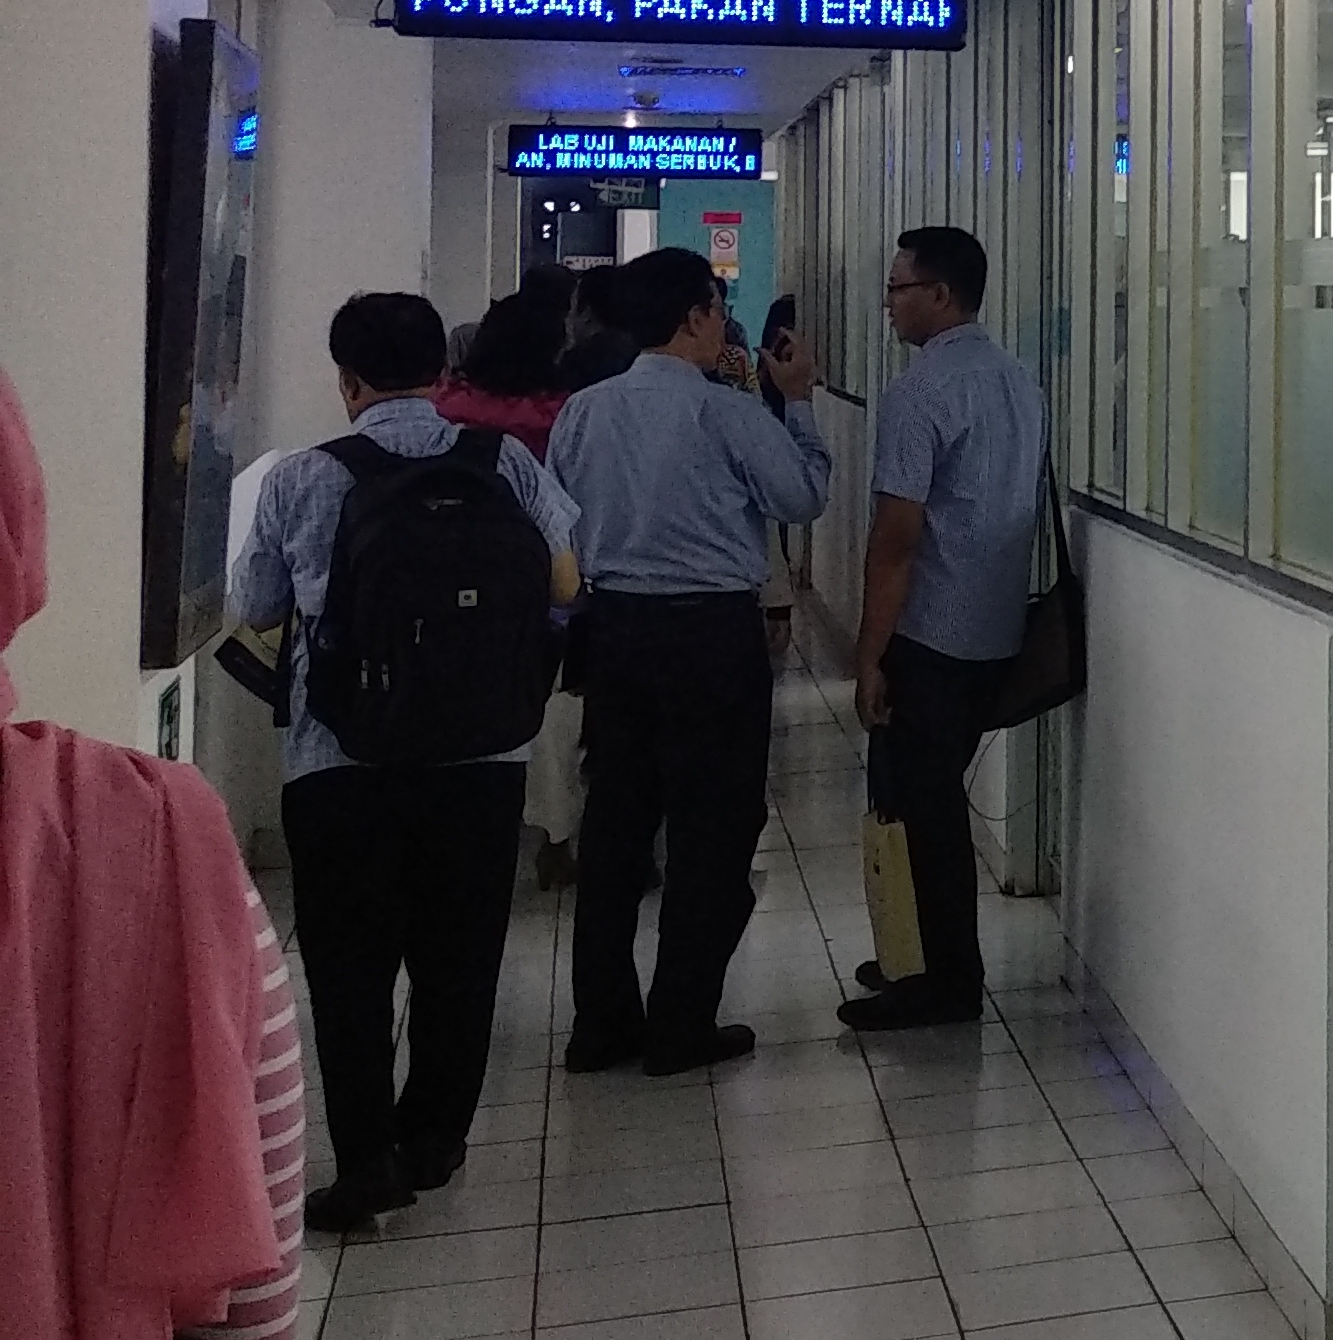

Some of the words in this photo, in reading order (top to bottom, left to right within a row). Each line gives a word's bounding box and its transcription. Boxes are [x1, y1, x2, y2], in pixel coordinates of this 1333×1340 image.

[538, 133, 580, 150] LAB
[584, 134, 615, 151] UJI
[628, 135, 725, 152] MAKANAN
[556, 152, 651, 170] MINUMAN
